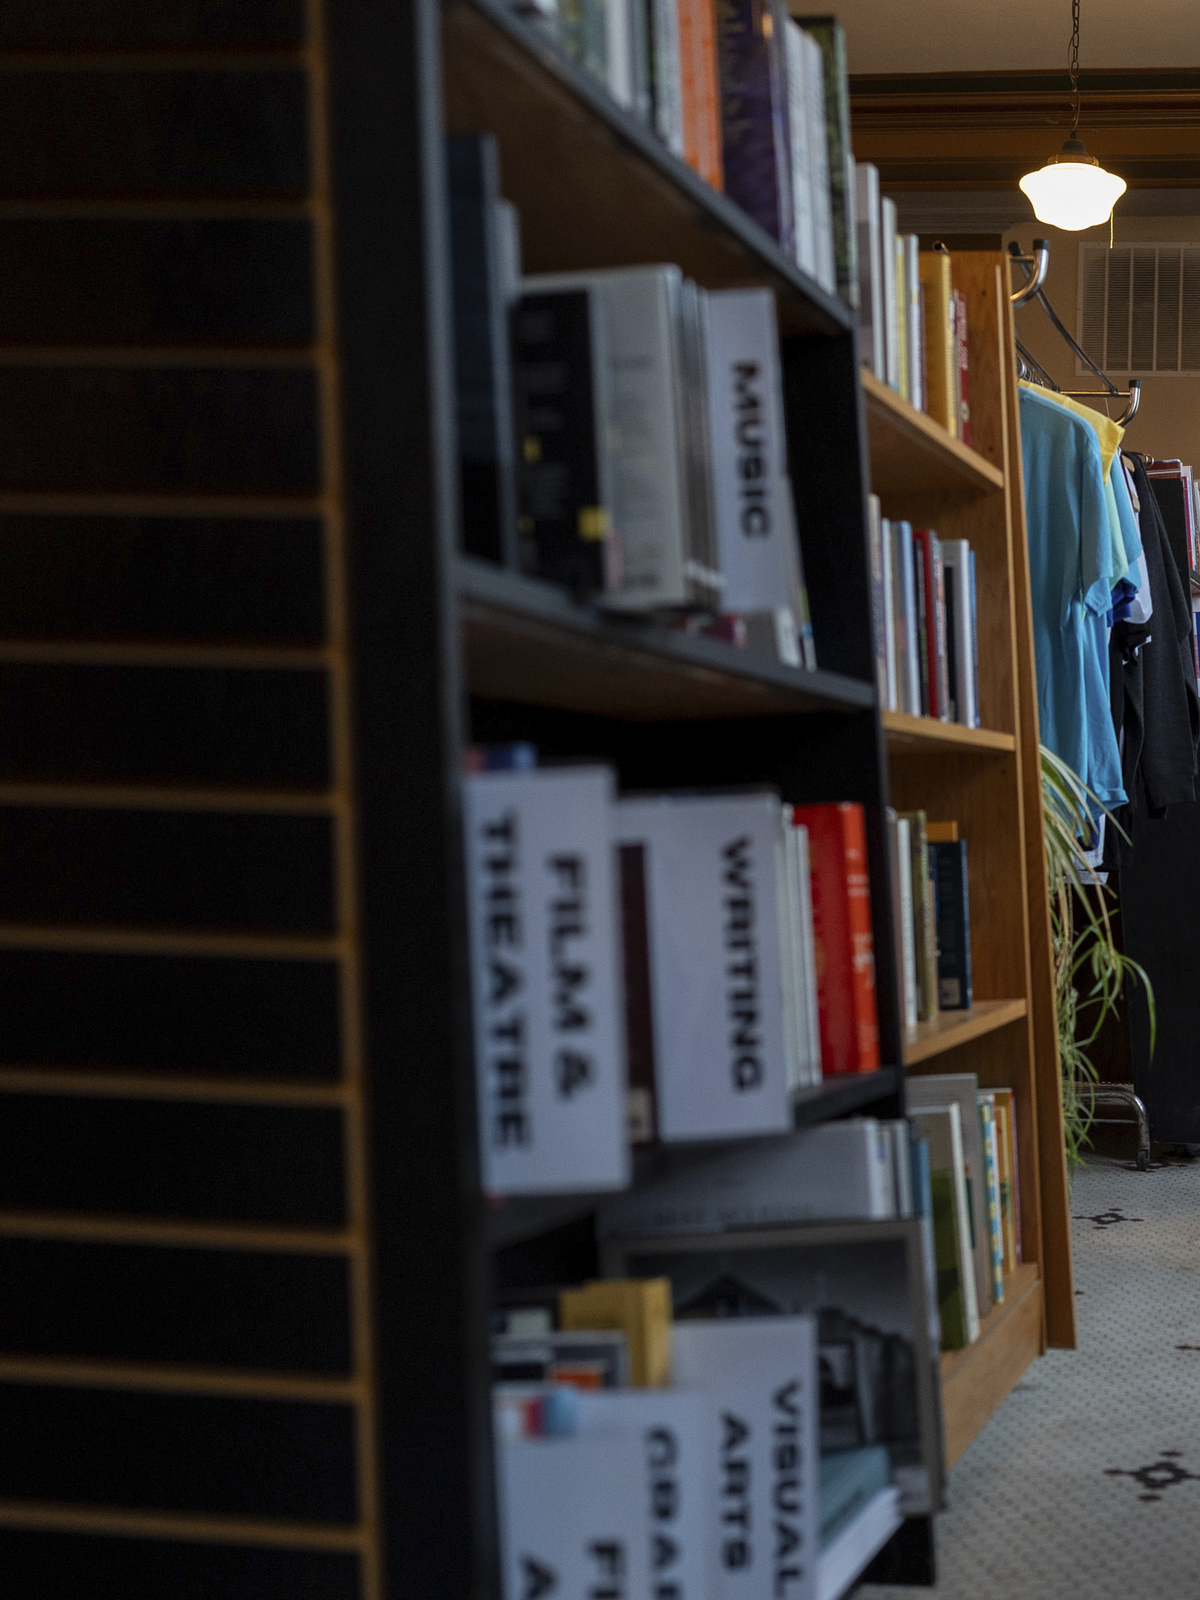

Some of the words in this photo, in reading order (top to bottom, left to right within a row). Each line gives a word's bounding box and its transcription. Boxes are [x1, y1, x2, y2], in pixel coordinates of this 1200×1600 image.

[731, 357, 773, 540] MUSIC
[484, 812, 530, 1148] THEATRE
[549, 855, 588, 1033] FILM
[723, 837, 764, 1092] WRITING
[722, 1411, 749, 1572] ARTS
[772, 1380, 800, 1600] VISUAL
